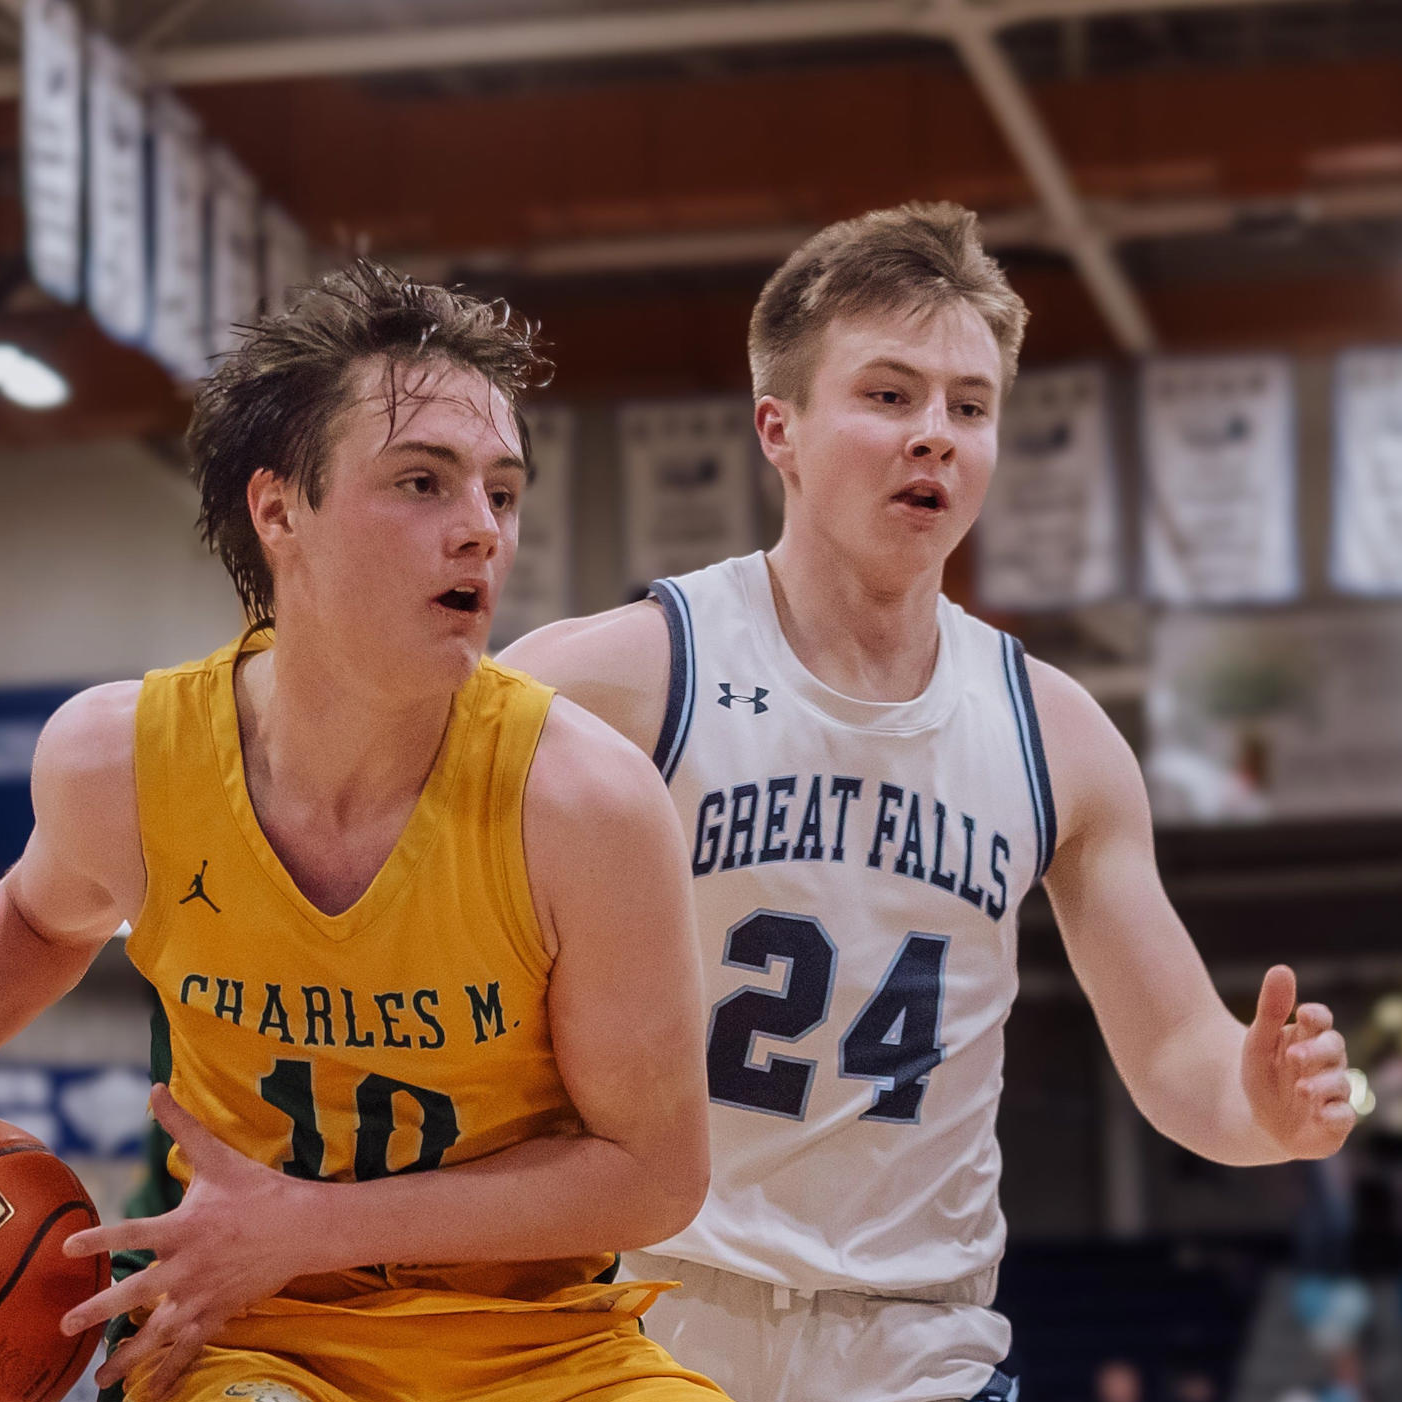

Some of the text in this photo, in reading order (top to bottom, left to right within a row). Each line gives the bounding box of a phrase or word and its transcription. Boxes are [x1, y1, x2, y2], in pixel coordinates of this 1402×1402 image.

[692, 774, 1011, 924] GREAT FALLS
[464, 980, 521, 1046] M.
[705, 907, 953, 1126] 24
[258, 1057, 462, 1184] 10
